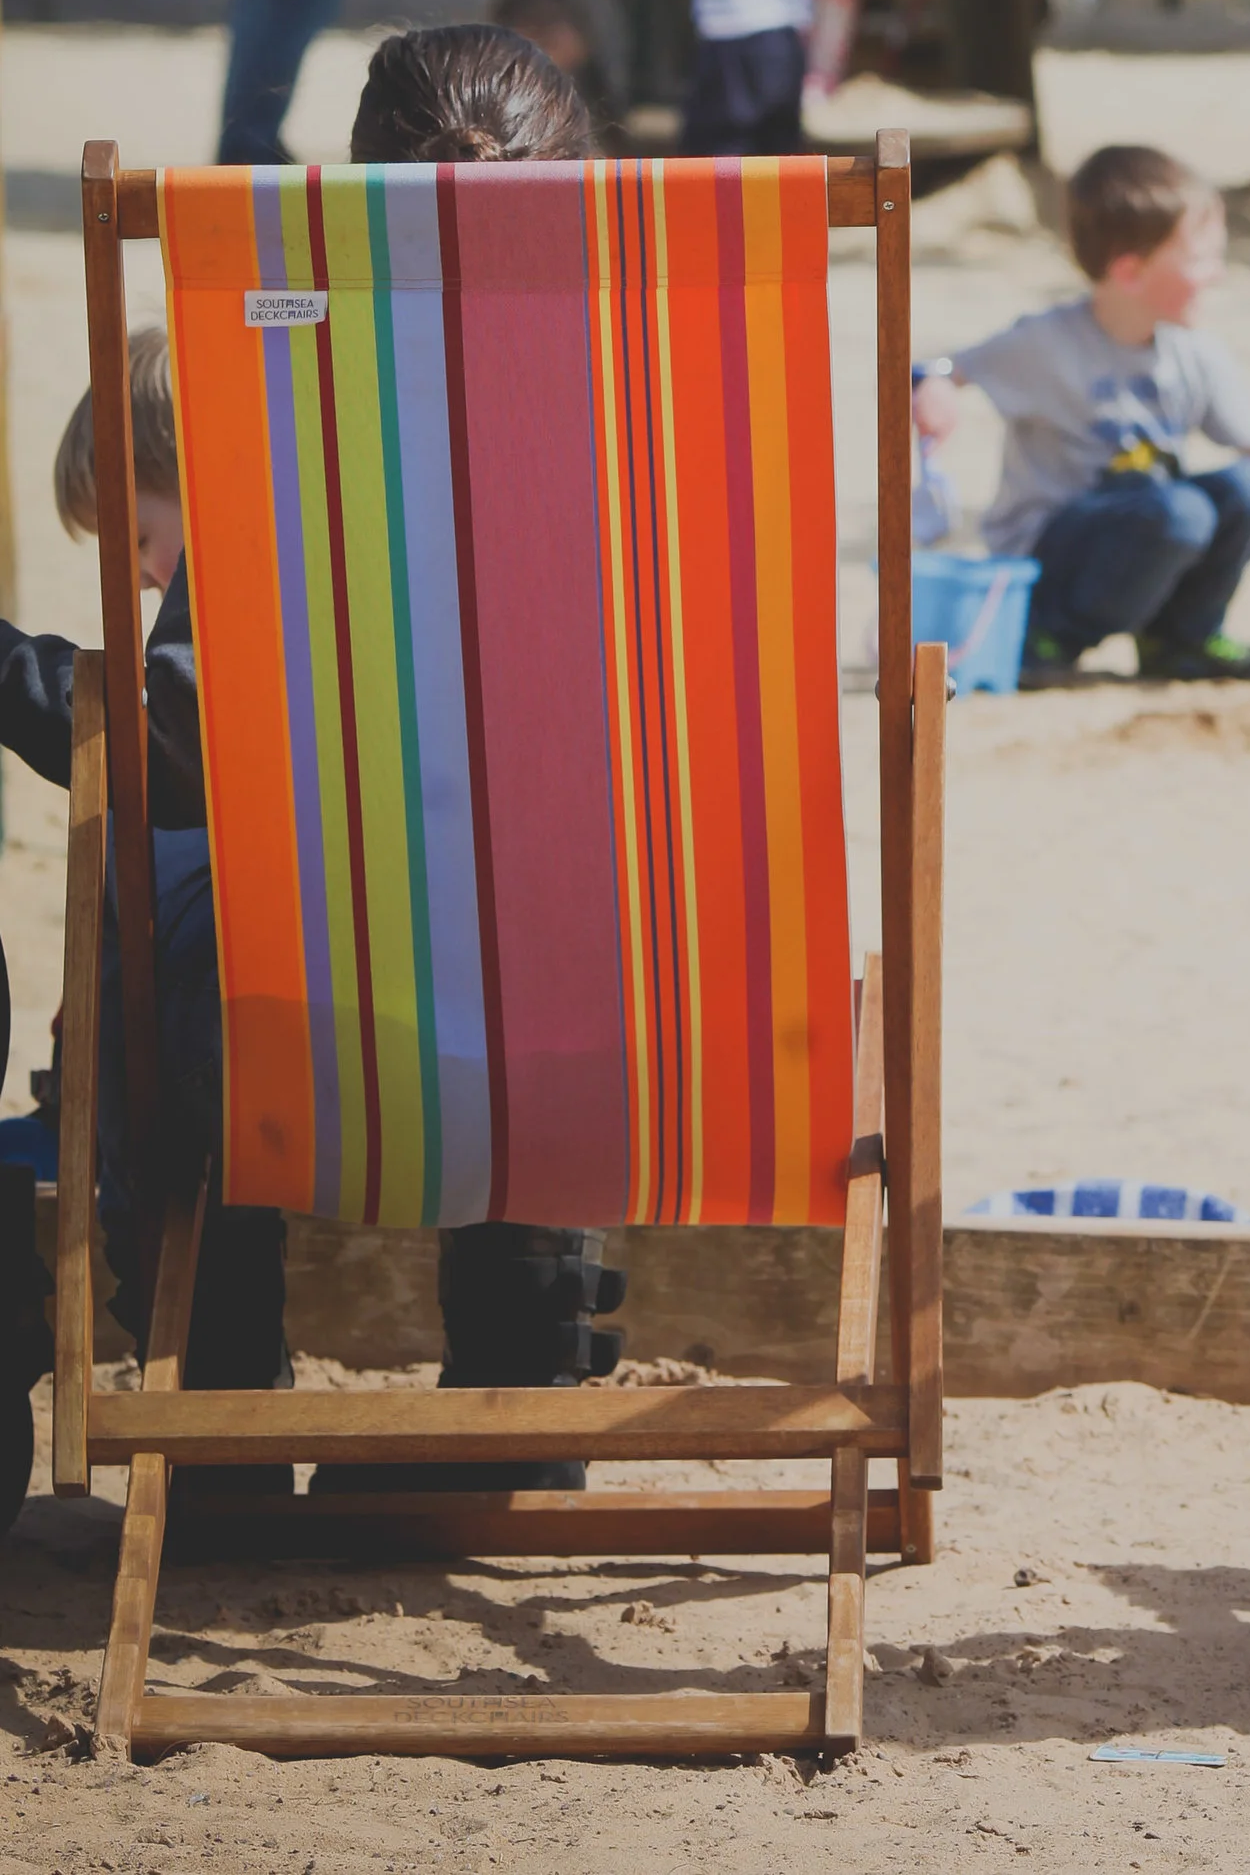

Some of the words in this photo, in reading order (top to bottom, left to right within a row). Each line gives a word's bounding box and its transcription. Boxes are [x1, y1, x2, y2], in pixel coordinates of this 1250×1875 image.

[256, 299, 314, 309] SOUTHSEA
[250, 309, 319, 321] DECKCHAIRS
[407, 1696, 557, 1709] SOUTHSEA
[393, 1711, 569, 1723] DECKCHAIRS
